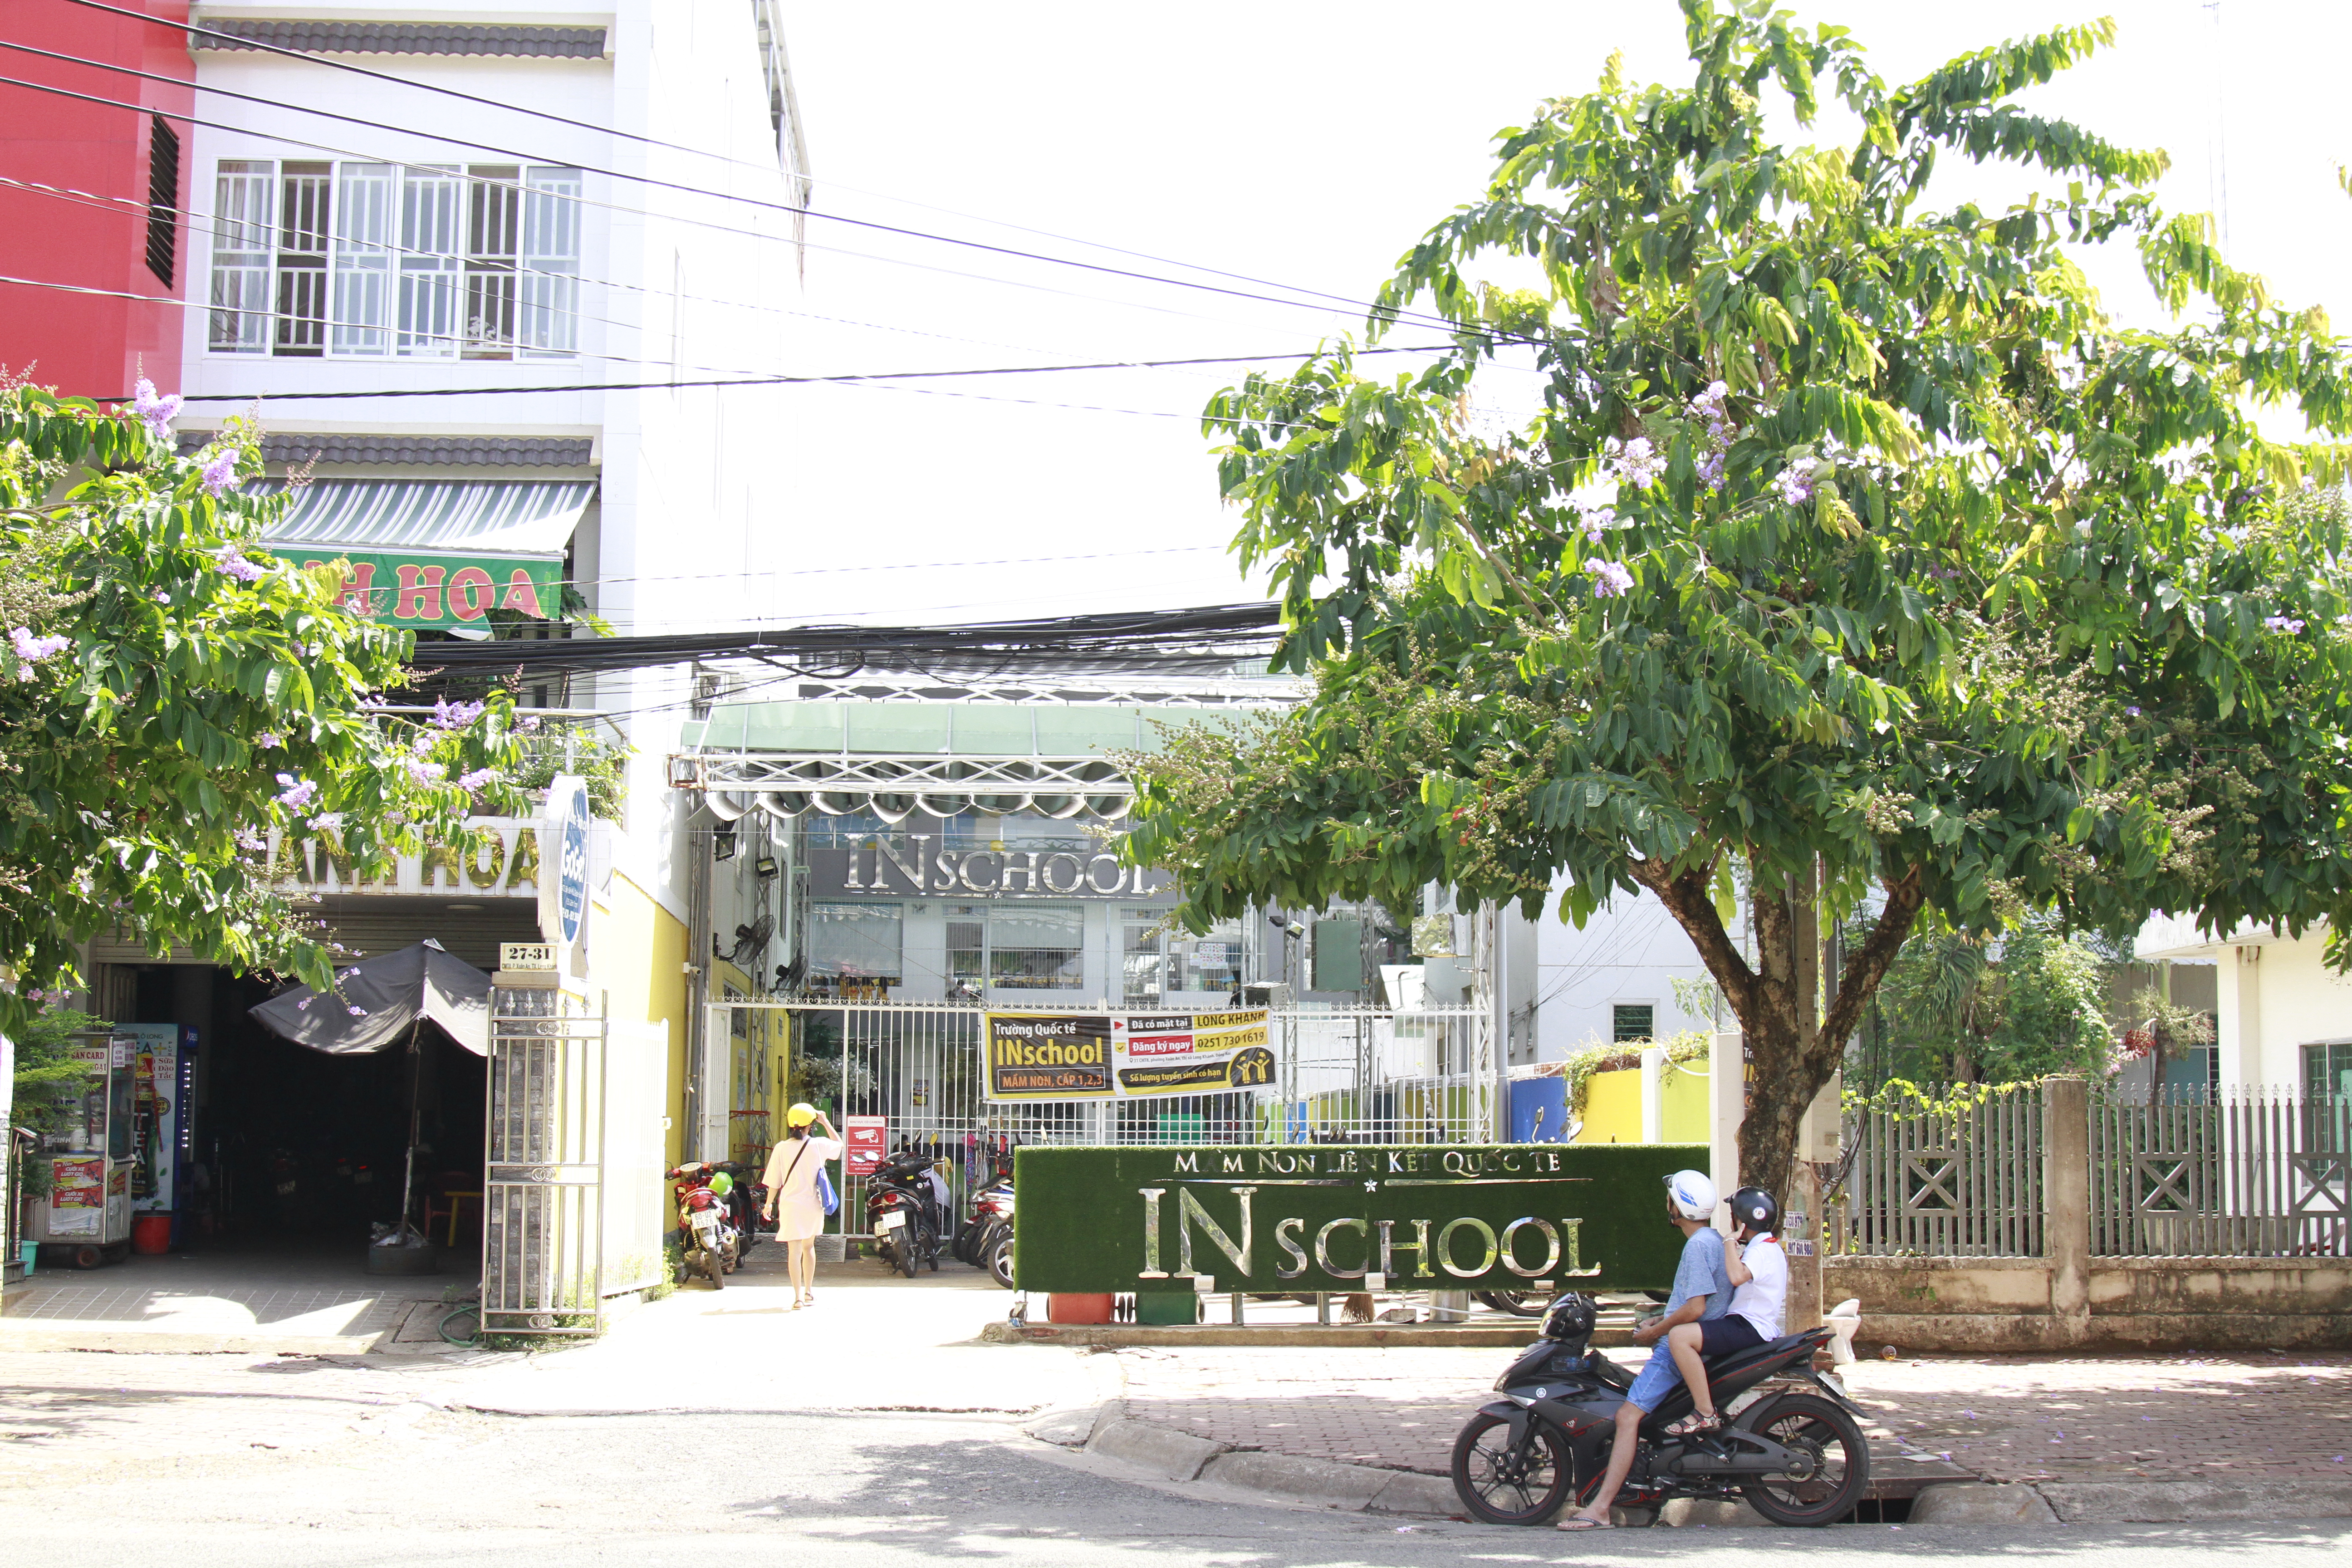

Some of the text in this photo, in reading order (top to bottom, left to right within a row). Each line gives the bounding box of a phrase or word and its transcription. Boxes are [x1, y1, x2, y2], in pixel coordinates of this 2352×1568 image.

[393, 562, 546, 622] HOA
[421, 824, 539, 888] HOA
[509, 947, 550, 960] 27-31
[994, 1021, 1077, 1038] Trường Quốc tế
[1132, 1020, 1144, 1029] Đã
[1145, 1019, 1154, 1029] có
[1156, 1019, 1174, 1030] mặt
[1176, 1018, 1188, 1029] tại
[1197, 1015, 1225, 1027] LONG
[1132, 1031, 1265, 1053] Đăng ký ngay 0251 730 1619
[86, 1051, 105, 1059] CARD
[997, 1037, 1103, 1066] INschool
[1003, 1073, 1028, 1088] MẦM
[1029, 1075, 1055, 1088] NON,
[1056, 1072, 1076, 1087] CẤP
[1130, 1068, 1221, 1083] Số lượng tuyển sinh có hạn
[1258, 1151, 1316, 1174] NON
[696, 1218, 714, 1228] 9626
